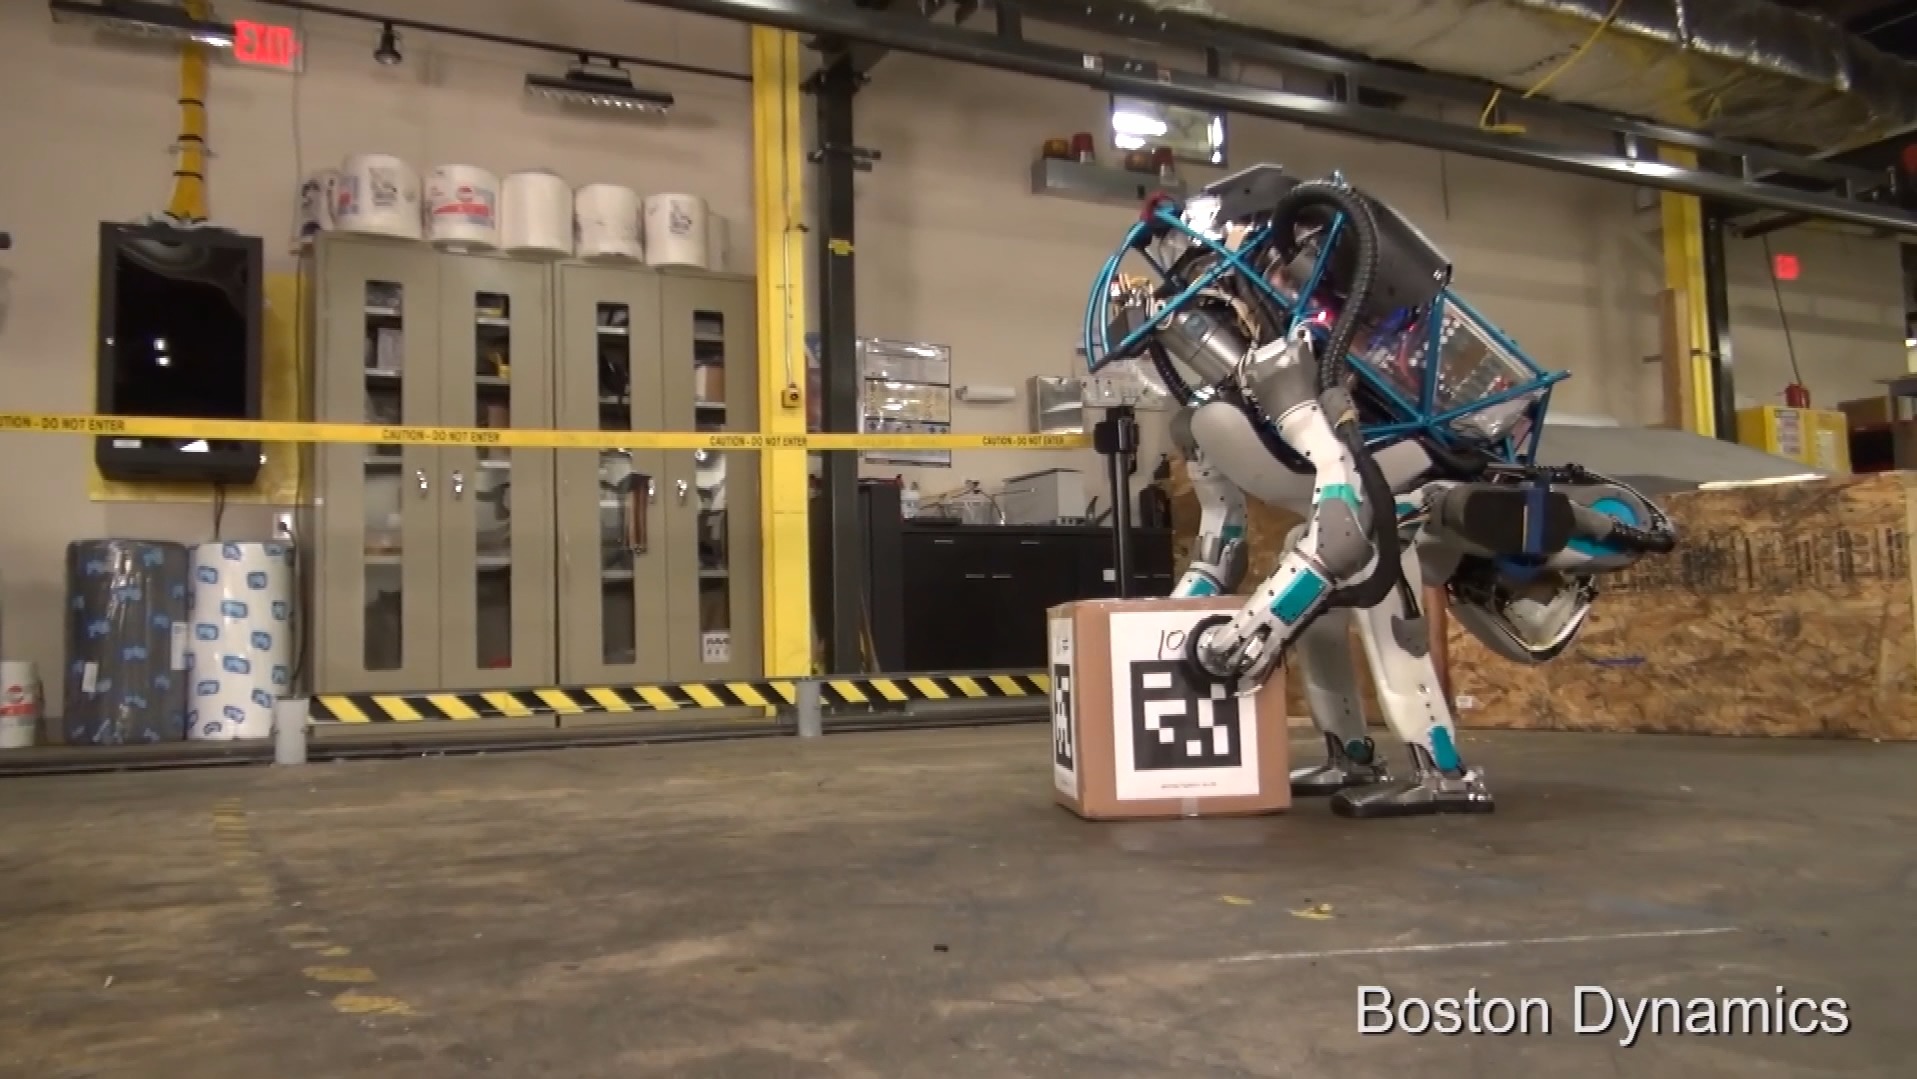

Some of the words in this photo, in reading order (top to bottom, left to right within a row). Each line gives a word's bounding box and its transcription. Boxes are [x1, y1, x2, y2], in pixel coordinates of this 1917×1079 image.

[41, 417, 58, 430] DO
[61, 417, 85, 431] NOT
[88, 418, 125, 431] ENTER
[382, 429, 424, 440] CAUTION
[432, 429, 446, 440] DO
[449, 430, 468, 441] NOT
[470, 431, 500, 442] ENTER
[710, 435, 744, 446] CAUTION
[751, 435, 763, 446] DO
[765, 436, 781, 446] NOT
[783, 437, 807, 446] ENTER
[982, 435, 1012, 446] CAUTION
[1028, 436, 1042, 446] NOT
